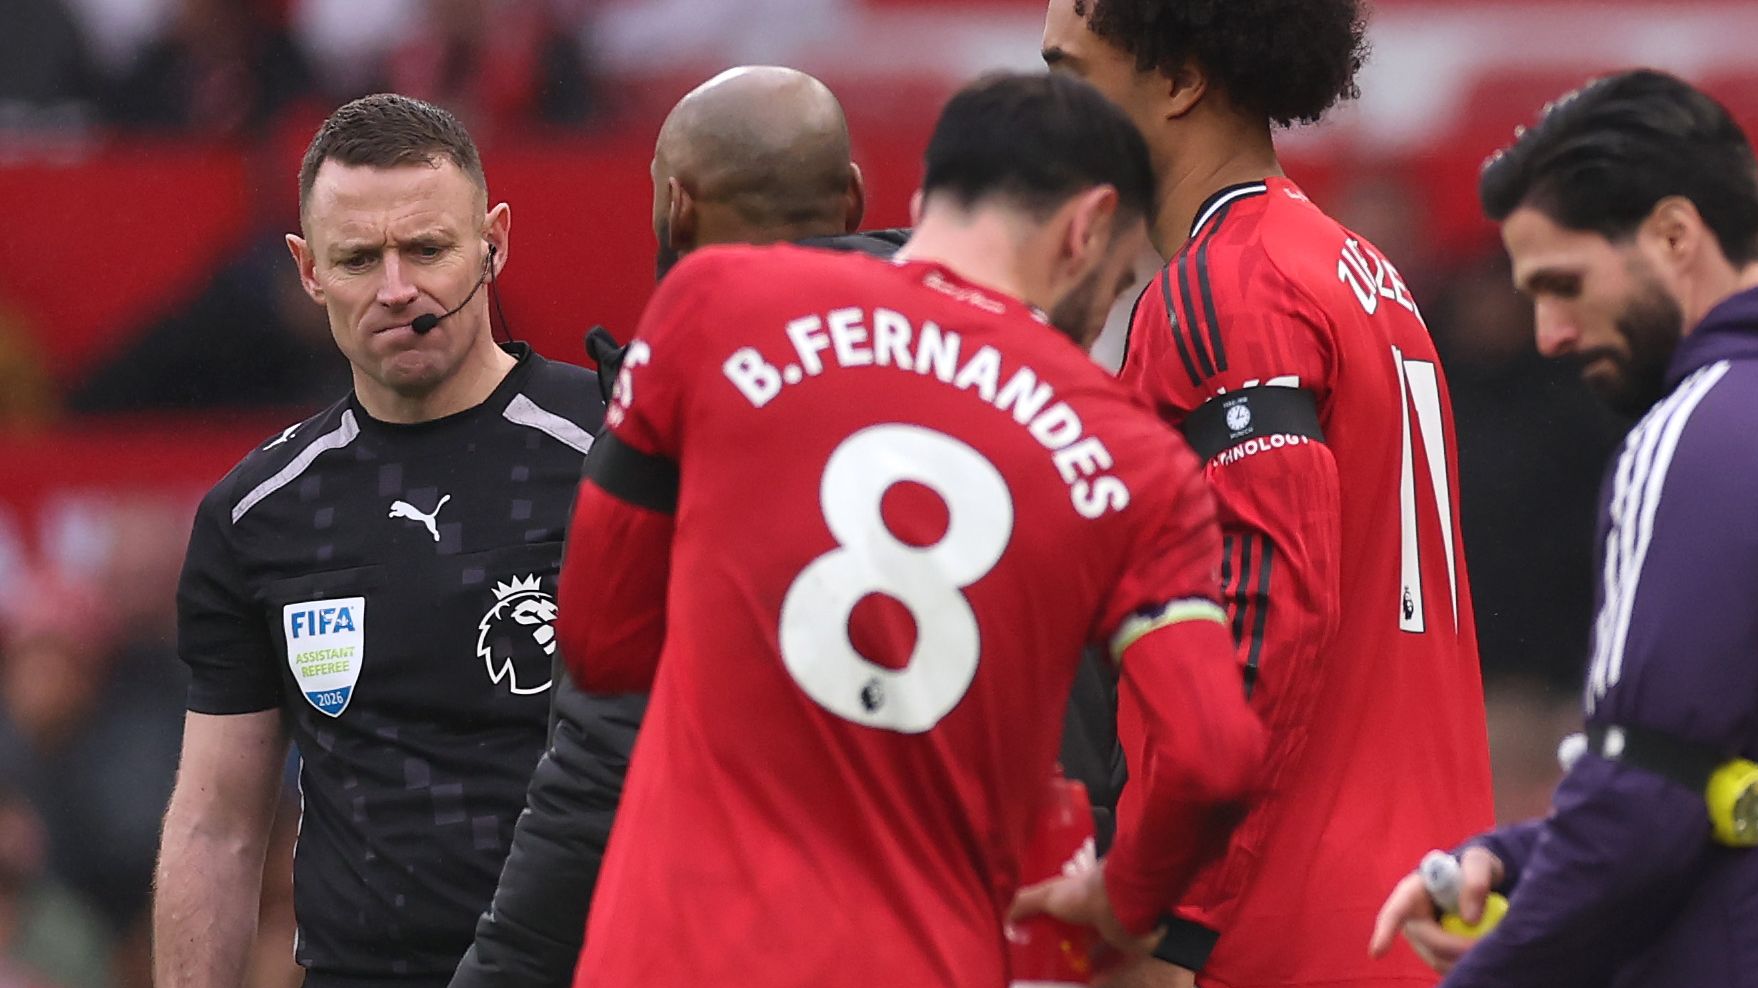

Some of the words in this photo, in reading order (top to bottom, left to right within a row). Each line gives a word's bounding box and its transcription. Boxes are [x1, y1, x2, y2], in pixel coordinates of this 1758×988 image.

[722, 307, 1131, 519] B.FERNANDES
[1392, 344, 1458, 635] 11
[778, 422, 1014, 734] 8
[291, 607, 355, 639] FIFA
[296, 646, 356, 664] ASSISTANT
[302, 660, 350, 678] REFEREE
[318, 691, 344, 707] 2026
